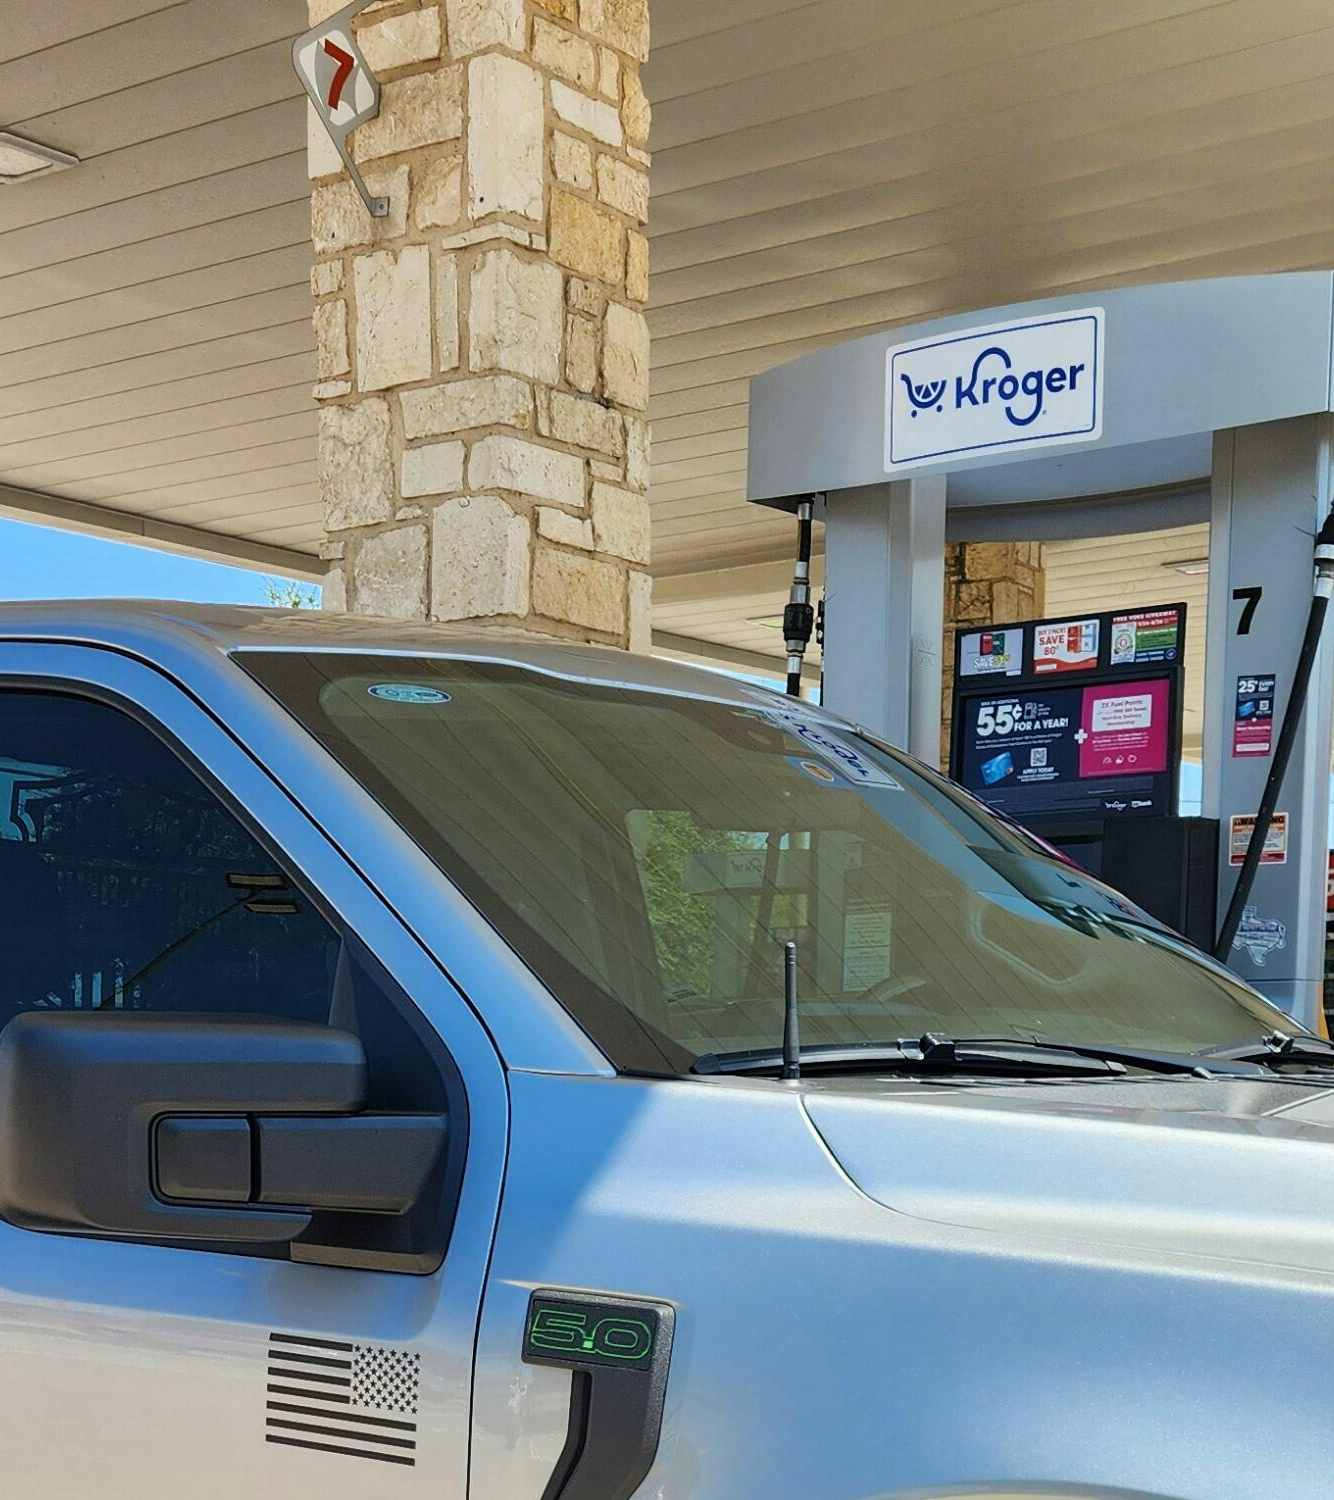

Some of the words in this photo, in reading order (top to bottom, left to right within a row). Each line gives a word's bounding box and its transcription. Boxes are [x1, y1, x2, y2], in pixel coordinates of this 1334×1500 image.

[324, 38, 355, 111] 7
[955, 347, 1085, 426] Kroger
[1232, 587, 1263, 635] 7
[1039, 635, 1064, 645] SAVE
[976, 704, 1022, 736] 55¢
[1014, 721, 1032, 732] FOR
[1034, 721, 1042, 730] A
[1042, 717, 1069, 728] YEAR!
[531, 1309, 652, 1359] 5.0
